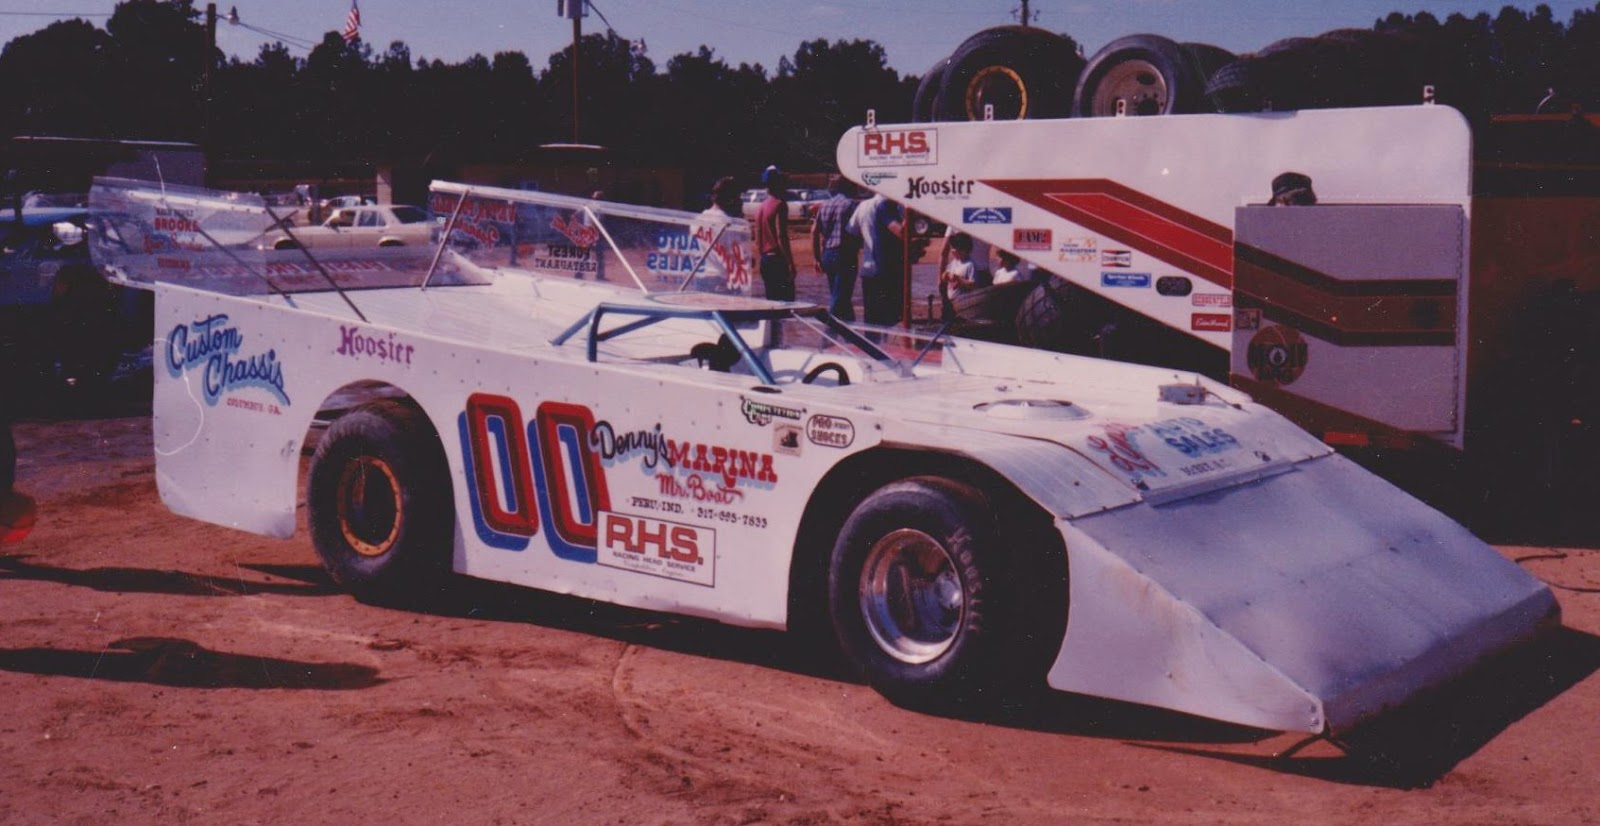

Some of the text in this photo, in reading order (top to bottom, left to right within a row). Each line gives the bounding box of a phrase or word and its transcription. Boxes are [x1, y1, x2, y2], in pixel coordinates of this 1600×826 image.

[904, 174, 975, 199] Hoosier
[168, 314, 243, 370] Custom
[336, 325, 414, 364] Hoosier
[205, 348, 291, 397] Chassis
[457, 392, 609, 564] 00
[591, 420, 778, 488] Denny's MARINA
[656, 474, 744, 504] Mr. Boat
[606, 515, 704, 565] R.H.S.
[612, 551, 640, 562] RACING
[643, 556, 663, 566] HEAD
[667, 560, 696, 573] SERVICE
